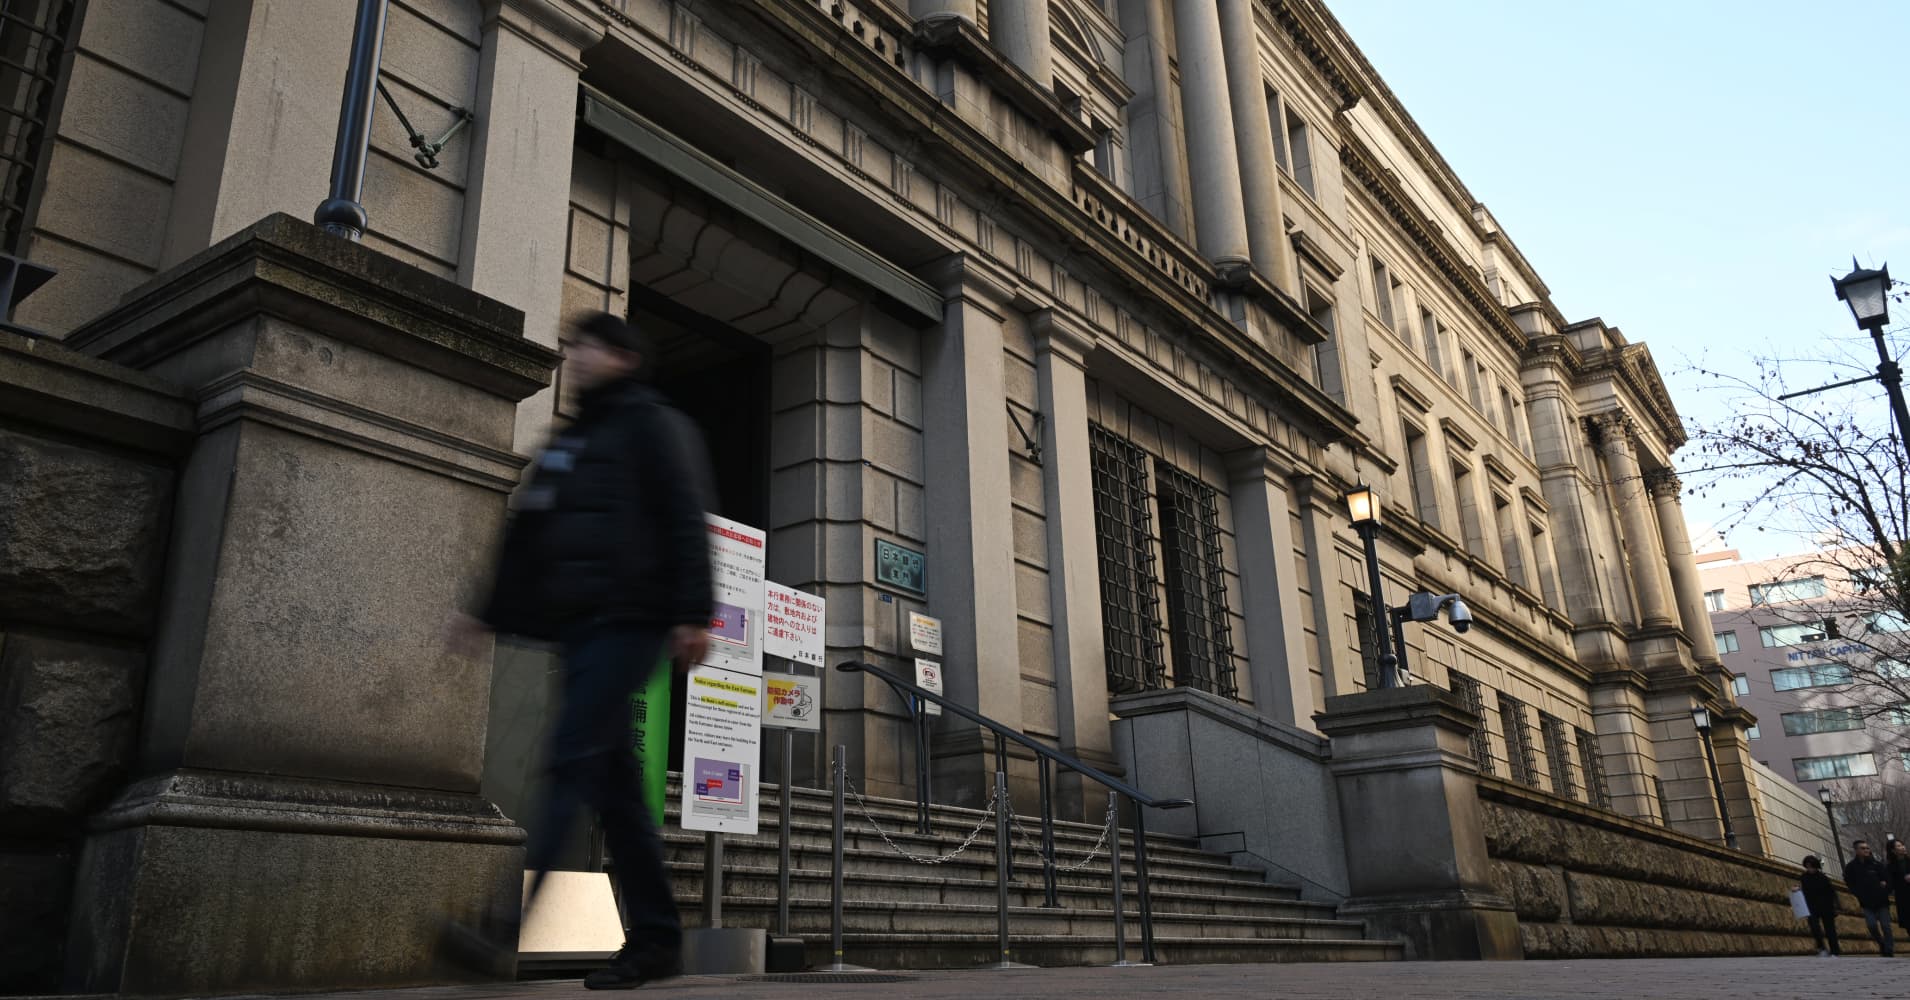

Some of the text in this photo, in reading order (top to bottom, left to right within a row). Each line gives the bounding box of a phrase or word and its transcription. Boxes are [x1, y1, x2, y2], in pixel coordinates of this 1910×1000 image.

[883, 548, 919, 569] 日本銀行
[798, 650, 823, 664] 日本銀行
[767, 687, 801, 698] 防犯カメラ
[773, 696, 794, 706] 作動中
